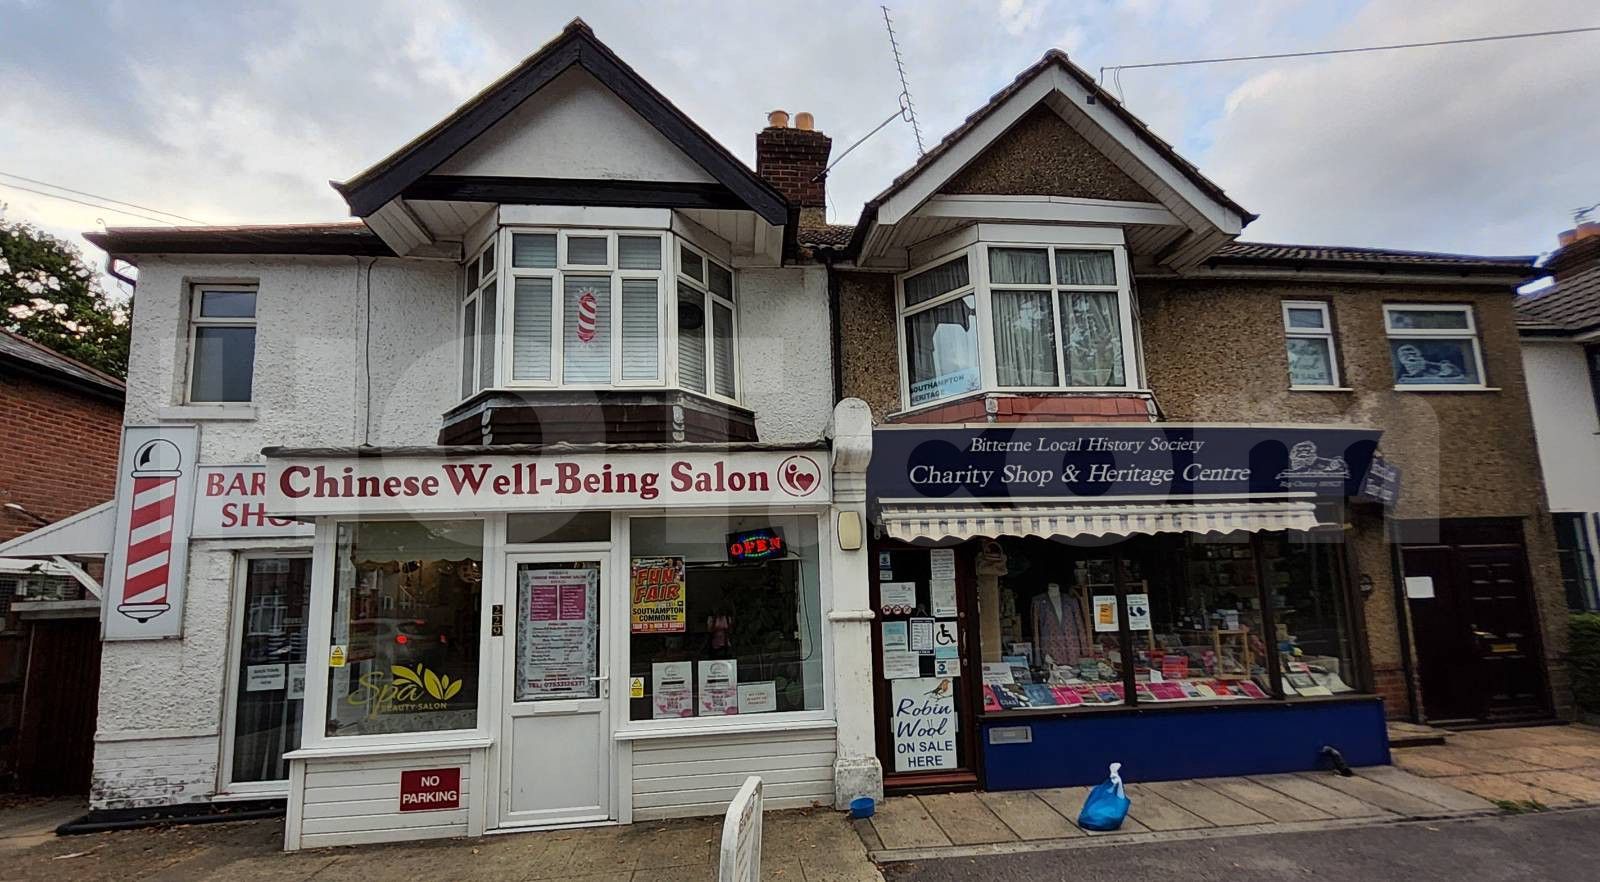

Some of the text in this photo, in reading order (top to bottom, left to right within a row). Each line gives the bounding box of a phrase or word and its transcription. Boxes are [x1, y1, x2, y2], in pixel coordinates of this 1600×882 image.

[969, 435, 1205, 456] Bitterne Local History Society
[279, 460, 770, 500] Chinese Well-Being Salon
[908, 462, 1251, 488] Charity Shop & Heritage Centre
[730, 537, 782, 555] OPEN
[635, 566, 676, 586] FUN
[633, 584, 680, 604] FAIR
[631, 607, 684, 615] SOUTHAMPTON
[638, 614, 671, 622] COMMON
[346, 671, 424, 721] Spa
[381, 702, 448, 713] BEAUTY SALON
[896, 698, 952, 718] Robin
[896, 718, 948, 738] Wool
[897, 740, 953, 754] ON SALE
[907, 755, 943, 768] HERE
[420, 776, 440, 787] NO
[402, 790, 458, 805] PARKING
